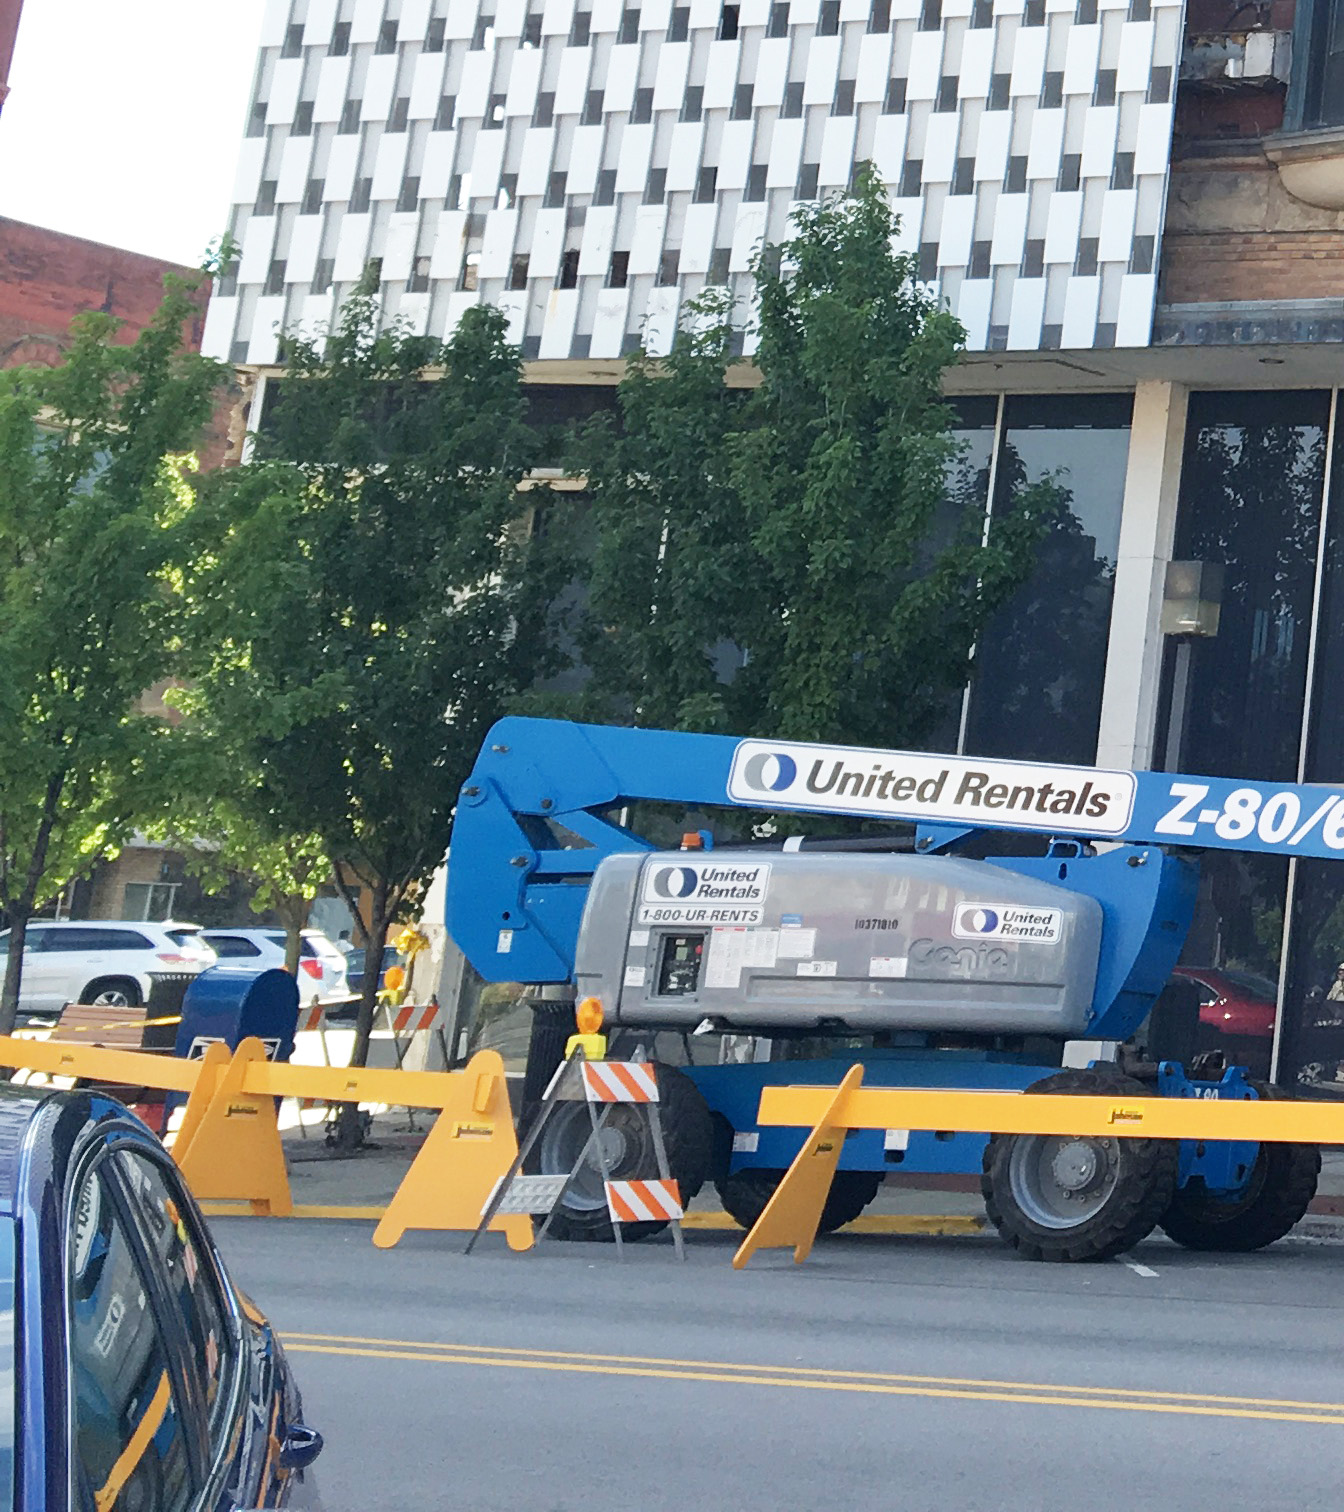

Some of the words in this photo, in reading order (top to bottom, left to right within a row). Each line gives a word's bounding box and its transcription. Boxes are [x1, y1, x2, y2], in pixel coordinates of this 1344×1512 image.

[804, 759, 948, 805] United
[952, 771, 1112, 819] Rentals
[701, 868, 760, 882] United
[697, 884, 761, 899] Rentals
[642, 909, 759, 922] 1-800-UR-RENTS
[1003, 910, 1054, 925] United
[1000, 923, 1055, 938] Rentals
